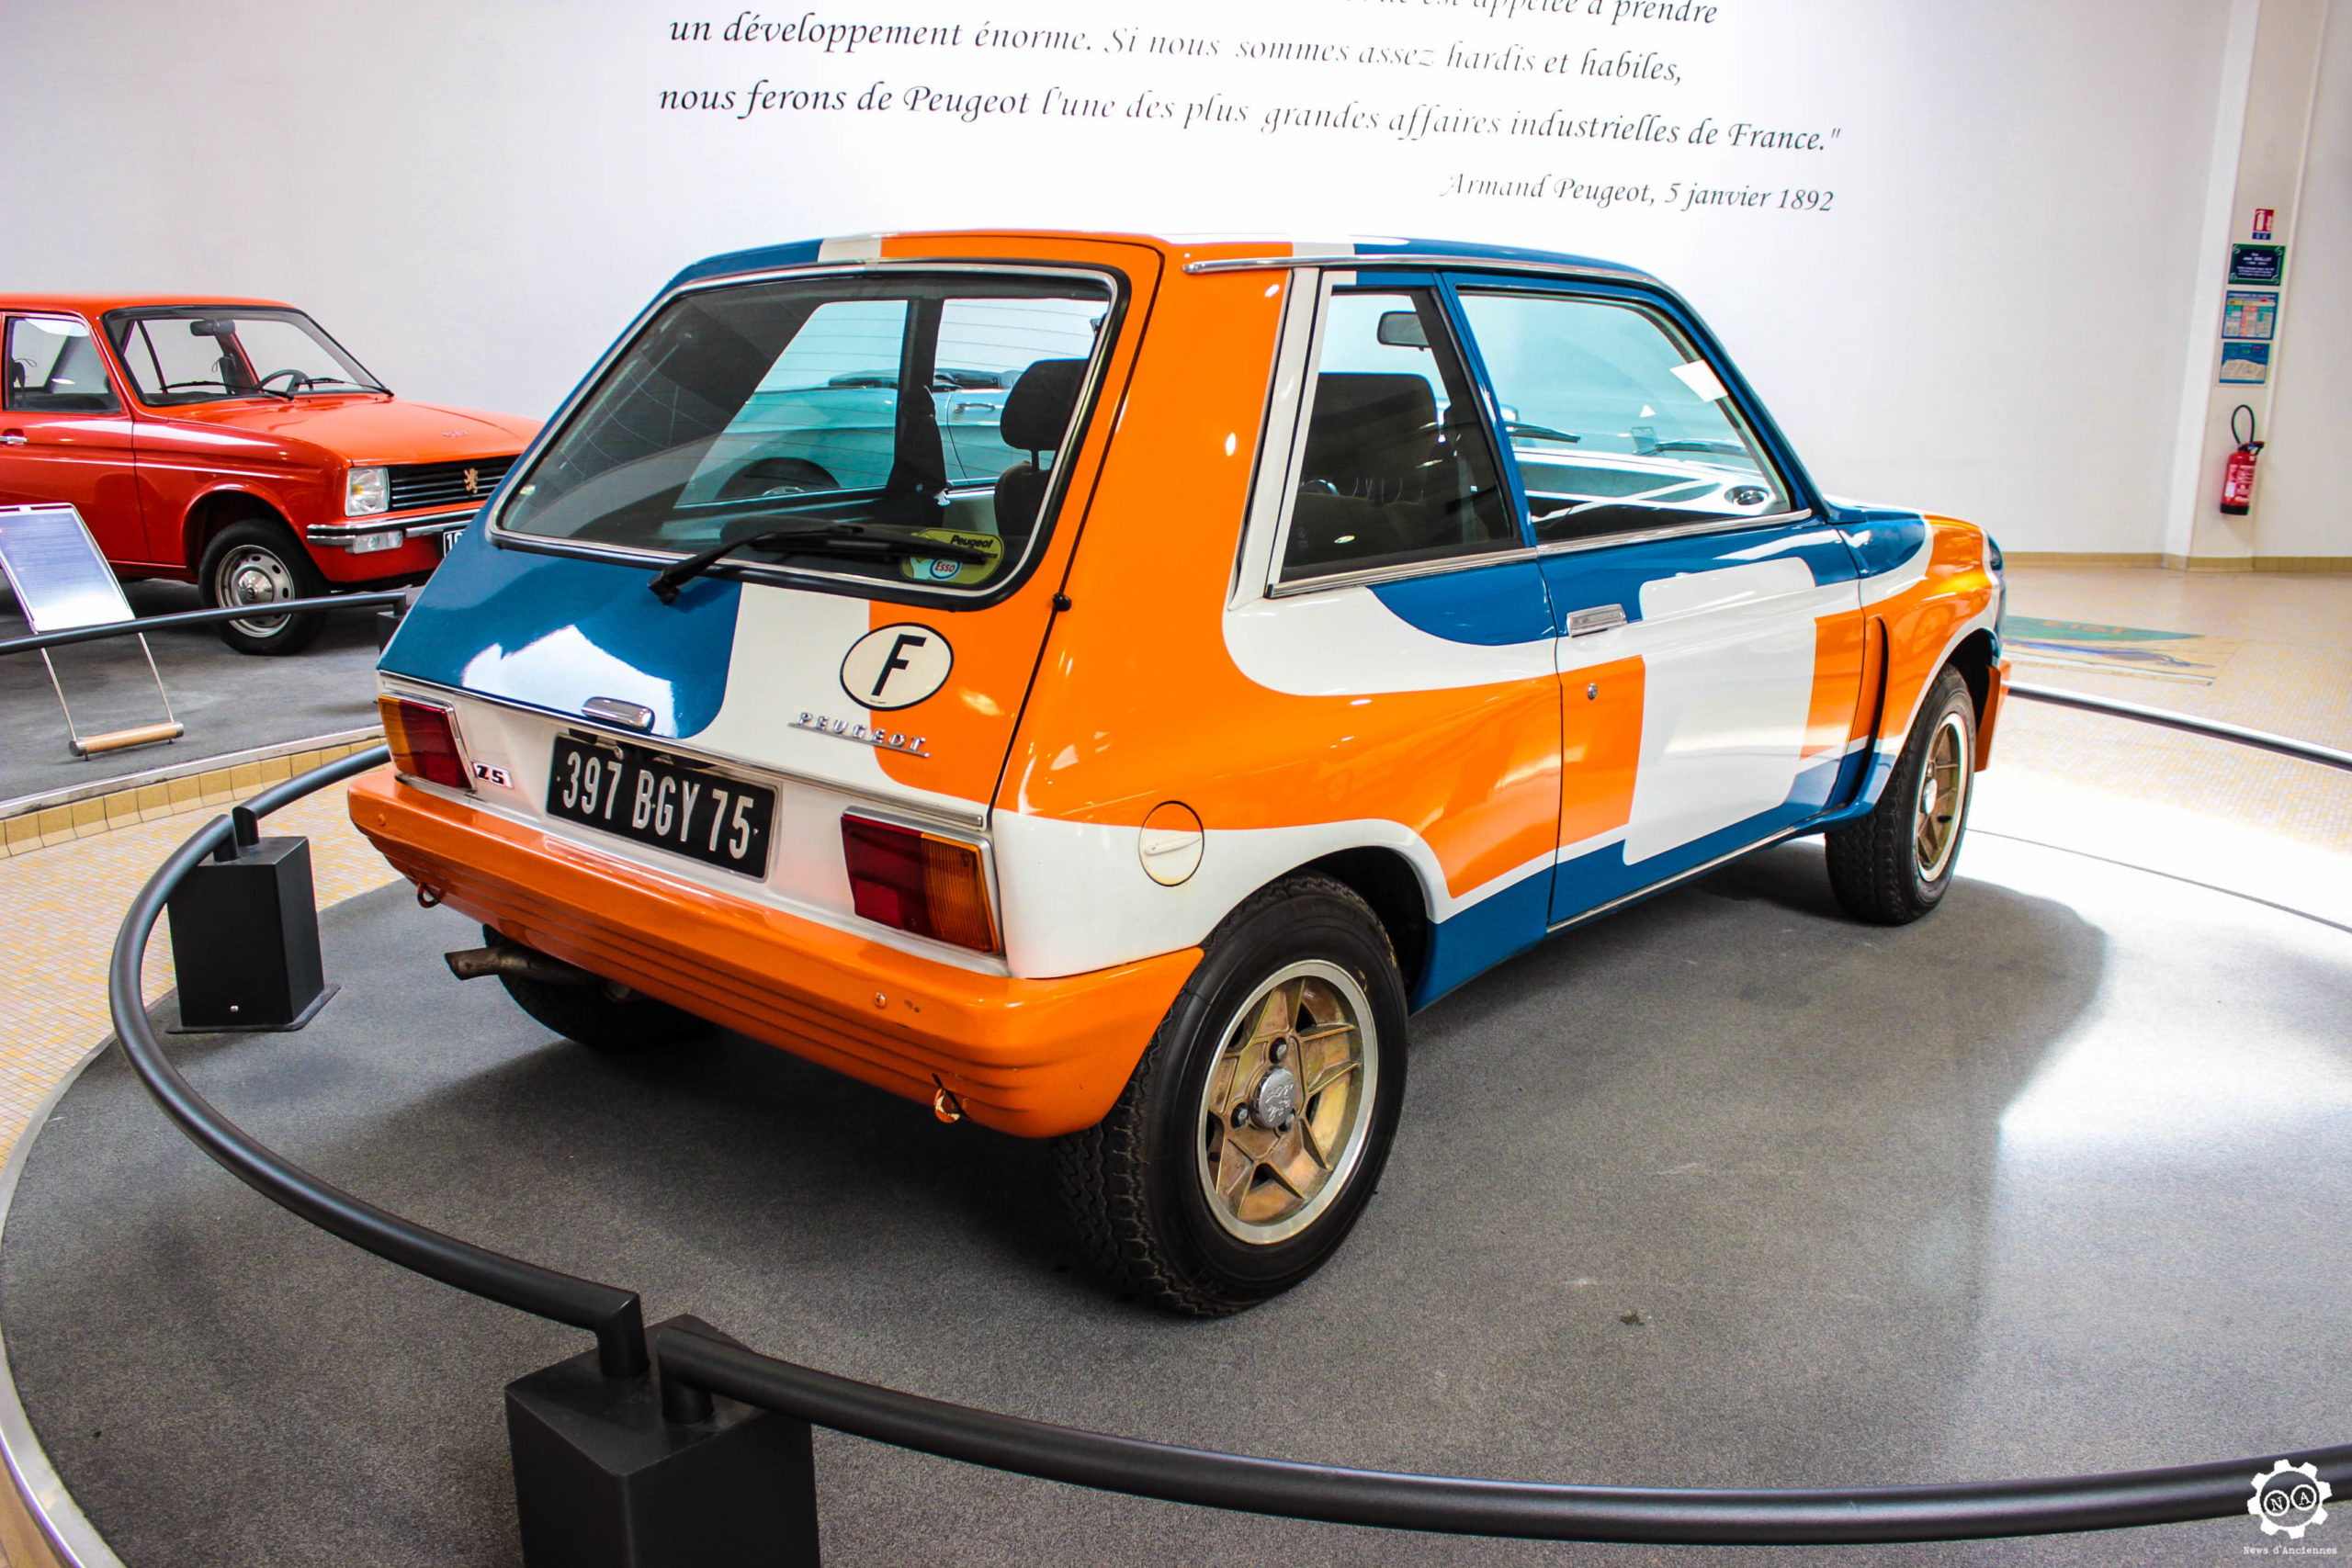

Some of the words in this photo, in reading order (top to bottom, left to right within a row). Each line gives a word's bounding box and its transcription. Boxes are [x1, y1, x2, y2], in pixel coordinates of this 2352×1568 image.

[1610, 0, 1718, 27] prendre
[669, 21, 713, 42] un
[723, 11, 963, 53] développement
[974, 20, 1091, 51] énorme.
[1103, 27, 1140, 54] Si
[1148, 36, 1221, 57] nous
[1235, 40, 1350, 62] sommes
[1358, 46, 1435, 67] assez
[1446, 39, 1536, 72] hardis
[1544, 53, 1569, 74] et
[1579, 48, 1681, 86] habiles,
[658, 90, 737, 110] nous
[737, 79, 848, 120] ferons
[856, 80, 894, 111] de
[902, 85, 1030, 123] Peugeot
[1041, 85, 1116, 118] l'une
[1125, 89, 1176, 119] des
[1182, 92, 1250, 130] plus
[1260, 100, 1380, 135] grandes
[1388, 103, 1502, 141] affaires
[1510, 109, 1681, 143] industrielles
[1687, 117, 1719, 145] de
[1440, 173, 1552, 198] Armand
[1553, 177, 1655, 209] Peugeot,
[1664, 182, 1682, 204] 5
[1680, 182, 1772, 212] janvier
[1777, 188, 1835, 212] 1892
[950, 535, 994, 549] Peugeot
[871, 633, 927, 697] F
[797, 711, 927, 752] PEUGEOT
[562, 750, 623, 820] 397
[632, 769, 701, 843] BGY
[708, 788, 754, 860] 75
